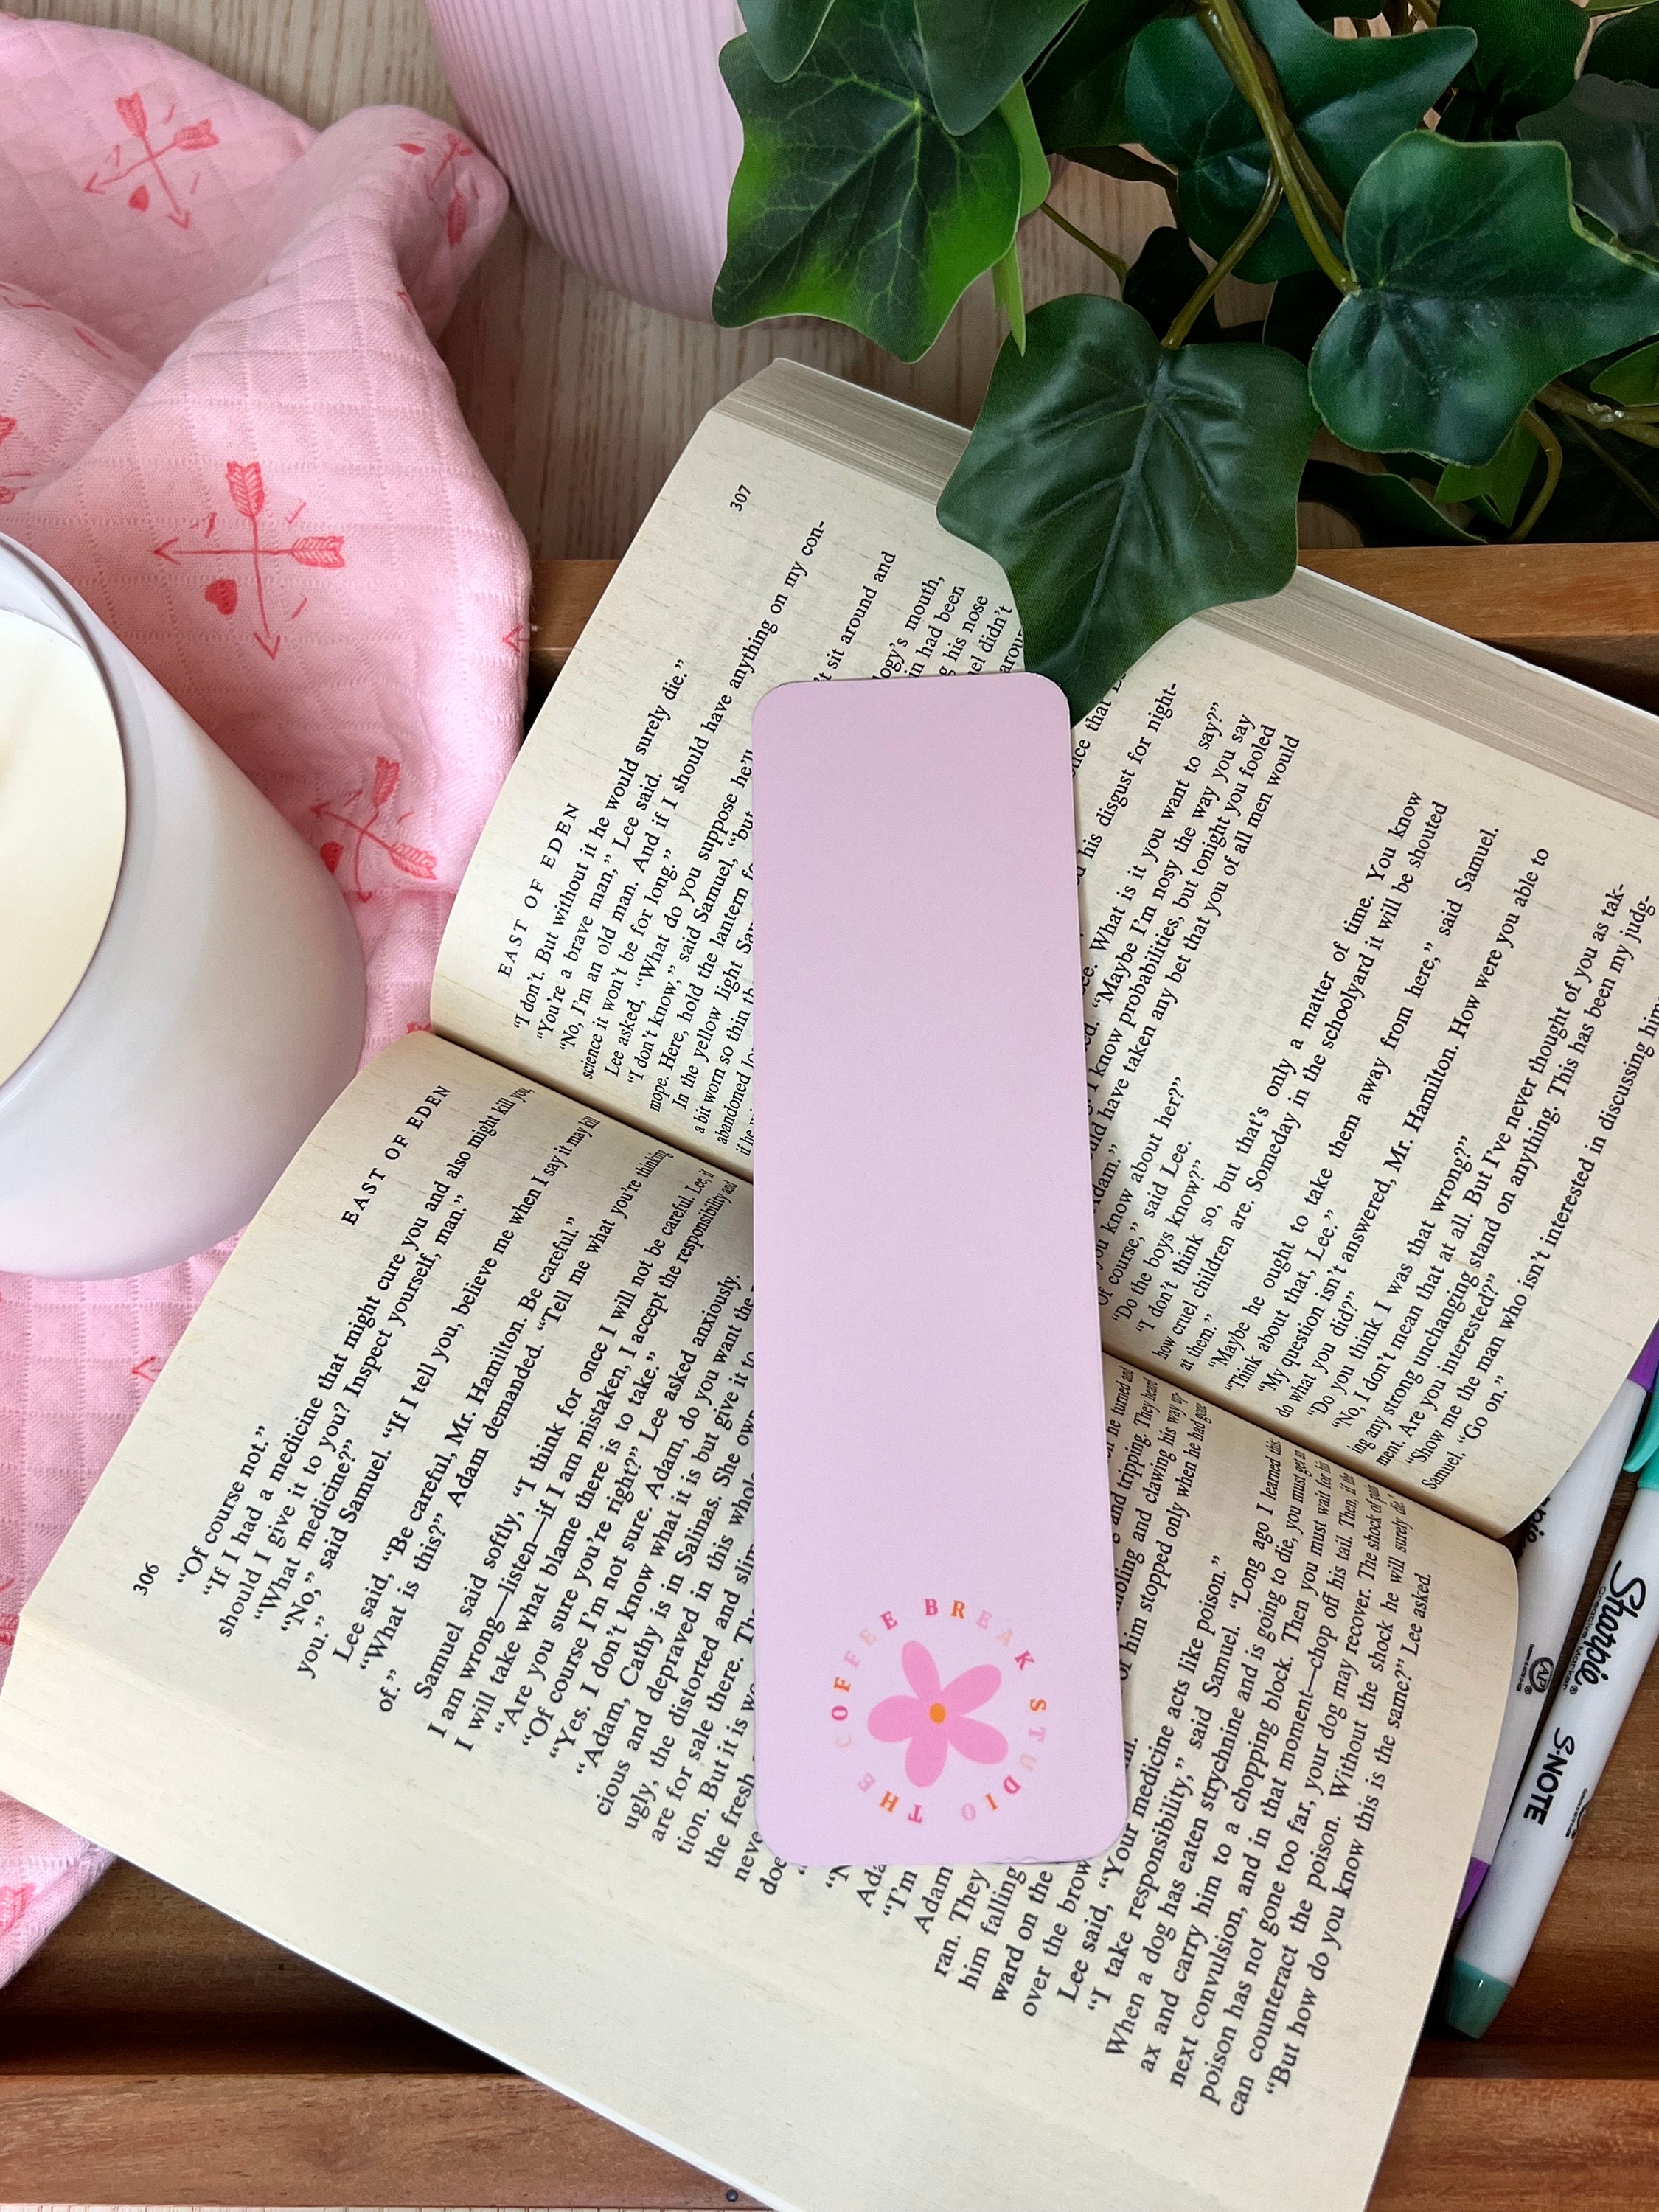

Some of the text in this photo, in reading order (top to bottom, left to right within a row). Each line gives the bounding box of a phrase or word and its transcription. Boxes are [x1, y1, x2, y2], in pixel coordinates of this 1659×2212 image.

[729, 484, 751, 512] 307
[513, 658, 688, 1029] “I don’t. But without it he would surely die.”
[1081, 683, 1177, 860] his disgust for night-
[1088, 701, 1222, 951] What is it you want to say?”
[497, 802, 580, 978] EAST OF EDEN
[536, 773, 664, 1040] “You’re a brave man,” Lee said.
[341, 1085, 451, 1227] EAST OF EDEN
[1256, 848, 1550, 1392] “My question isn’t answered, Mr. Hamilton. How were you able to
[1107, 1141, 1192, 1286] course,” said Lee.
[1110, 1159, 1205, 1321] “Do the boys know?”
[1307, 1135, 1473, 1416] “Do you think I was that wrong?”
[202, 1150, 472, 1596] “If I had a medicine that might cure you and also
[1224, 1209, 1339, 1391] “Think about that, Lee.”
[1274, 1290, 1358, 1419] do what you did?”
[176, 1425, 270, 1584] “Of course not.”
[332, 1217, 580, 1663] Lee said, “Be careful, Mr. Hamilton. Be careful.”
[494, 1274, 742, 1733] “Are you sure you’re right?” Lee asked anxiously.
[1420, 1374, 1509, 1490] Samuel. “Go on.”
[133, 1560, 159, 1597] 306
[254, 1438, 356, 1620] “What medicine?”
[453, 1351, 661, 1753] I will take what blame there is to take.”
[1196, 1554, 1227, 1637] poison.”
[296, 1615, 329, 1680] you.”
[379, 1669, 401, 1712] of.”
[831, 1597, 1047, 1823] THE COFFEE BREAK STUDIO
[1166, 1678, 1190, 1719] acts
[1177, 1637, 1205, 1674] like
[1087, 1503, 1274, 2011] “I take responsibility,” said Samuel. “Long ago I
[1131, 1725, 1175, 1818] medicine
[1265, 1572, 1432, 2094] “But how do you know this is the same?” Lee asked.
[933, 1868, 991, 1978] ran. They
[1056, 1958, 1089, 2004] Lee
[1081, 1904, 1114, 1953] said,
